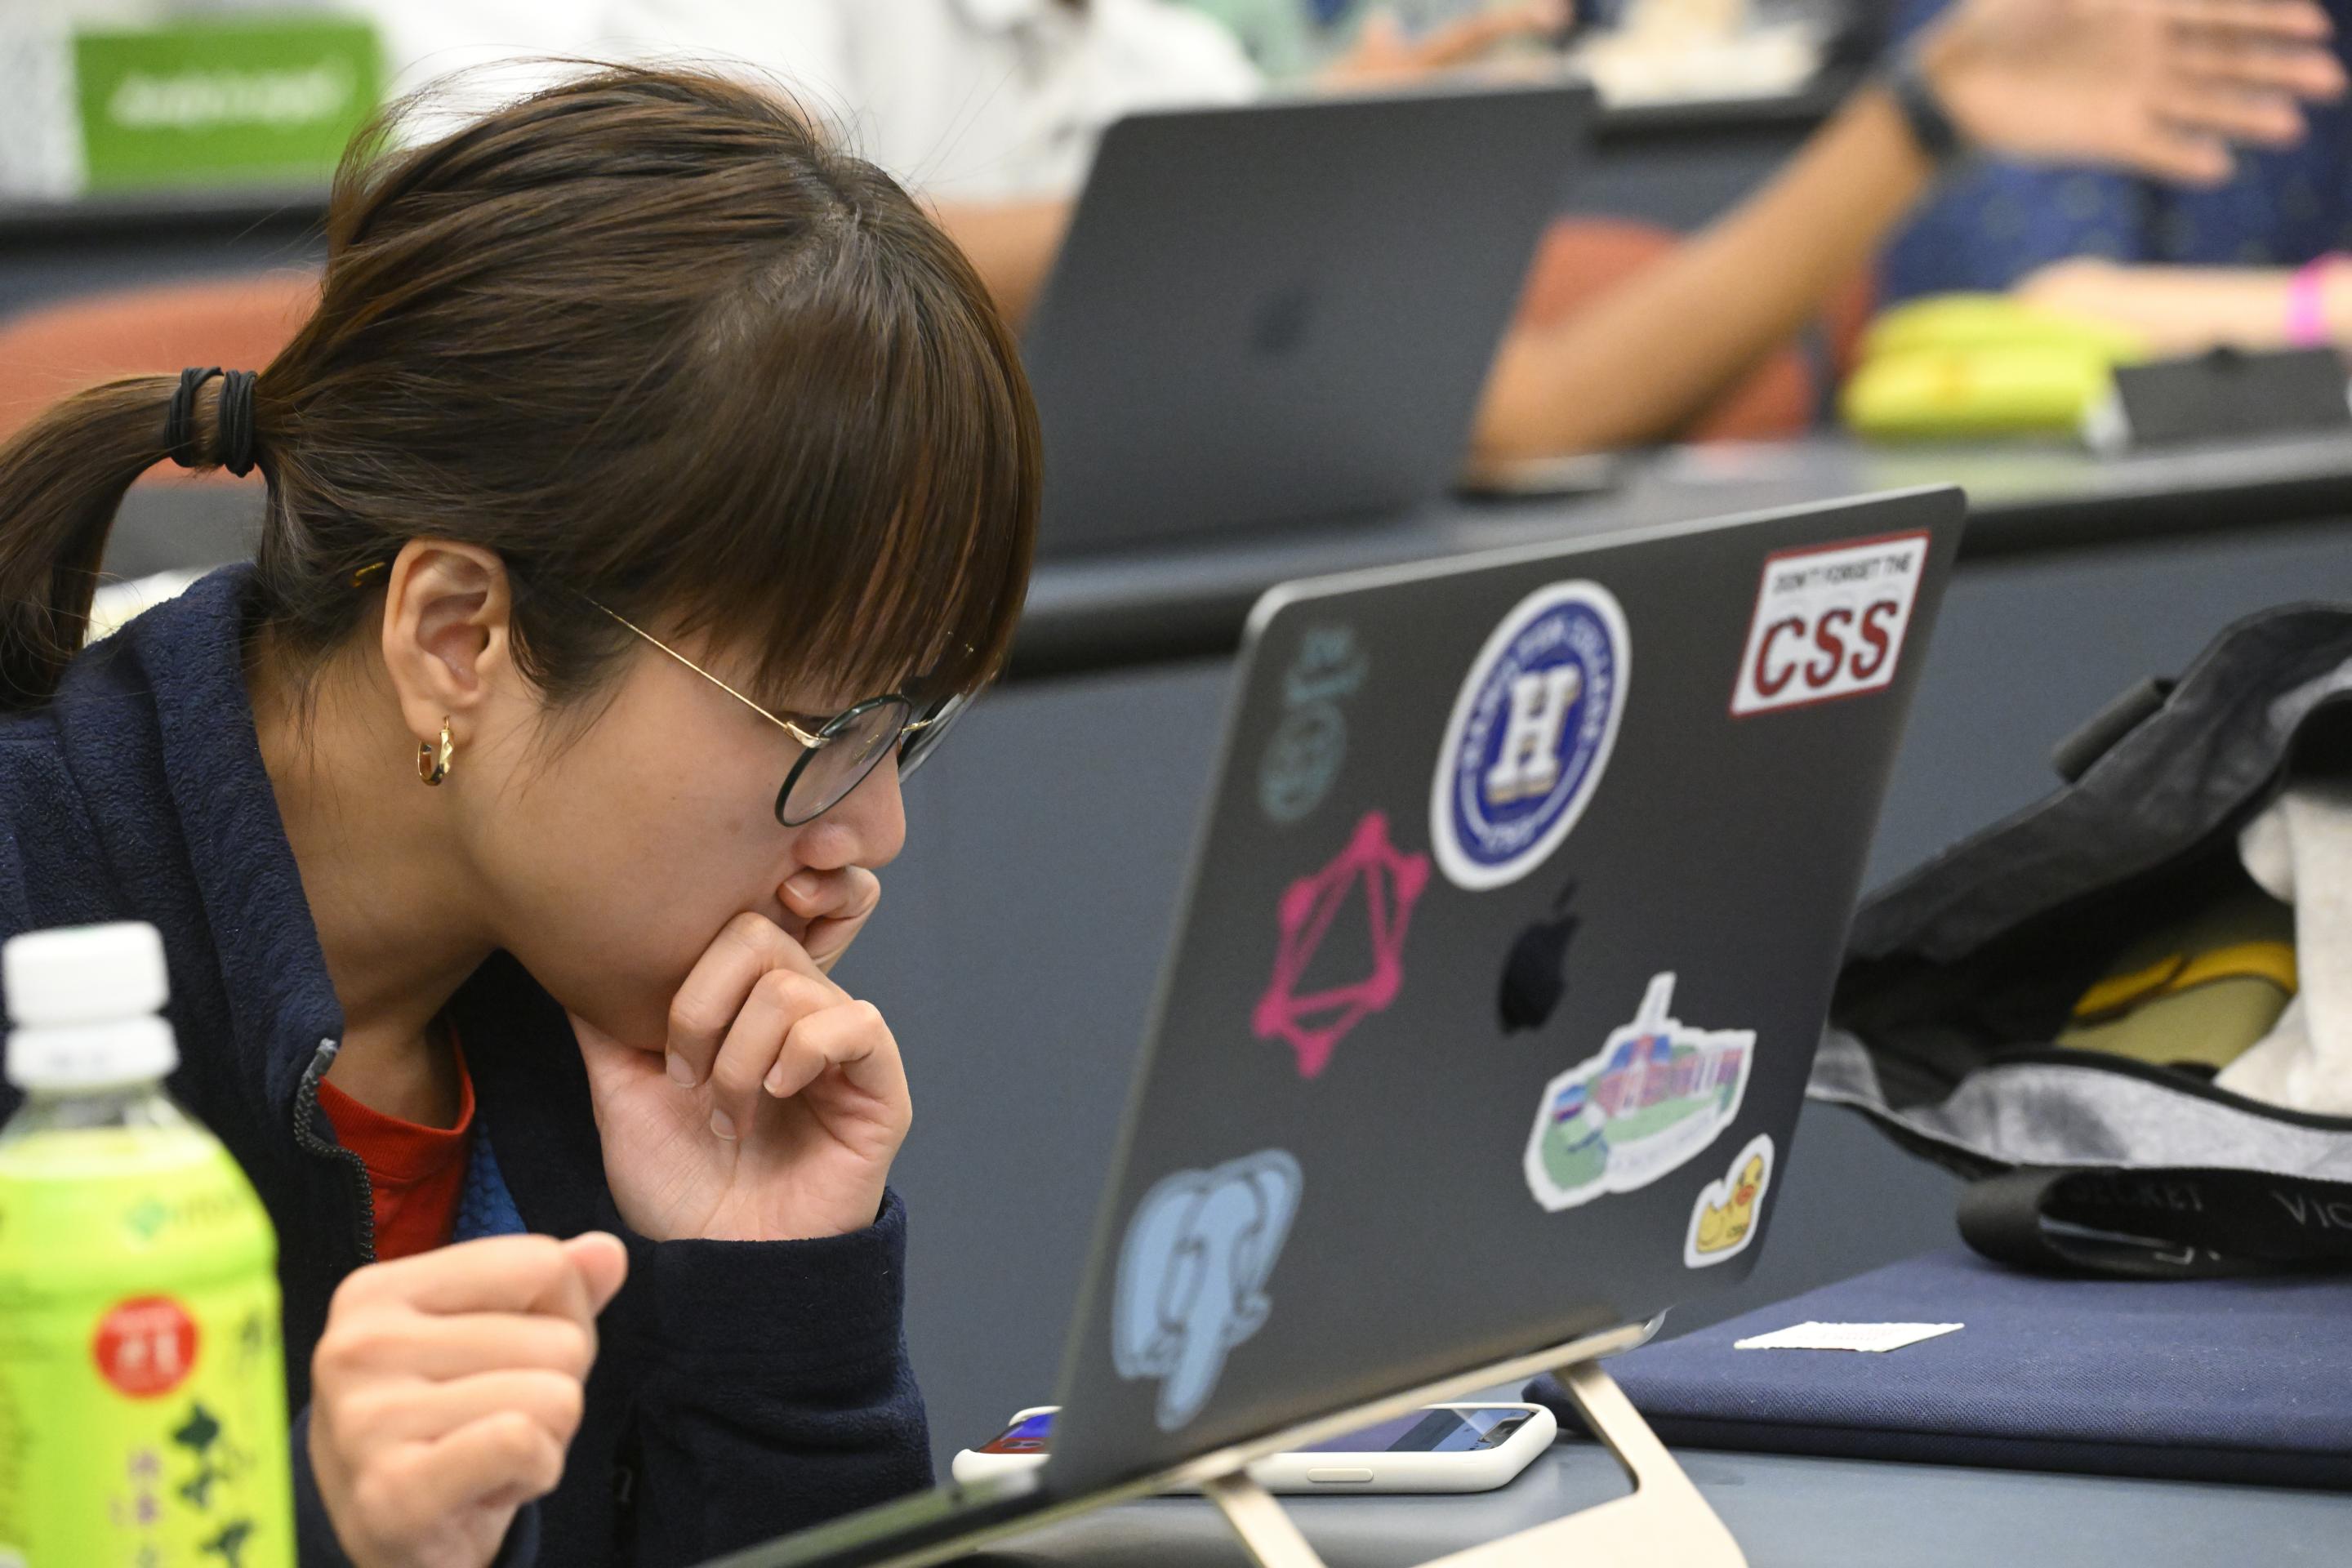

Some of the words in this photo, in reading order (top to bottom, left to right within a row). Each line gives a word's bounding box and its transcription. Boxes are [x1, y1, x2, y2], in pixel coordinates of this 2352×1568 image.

[1883, 552, 1913, 573] THE
[1754, 600, 1897, 697] CSS
[1486, 662, 1580, 805] H
